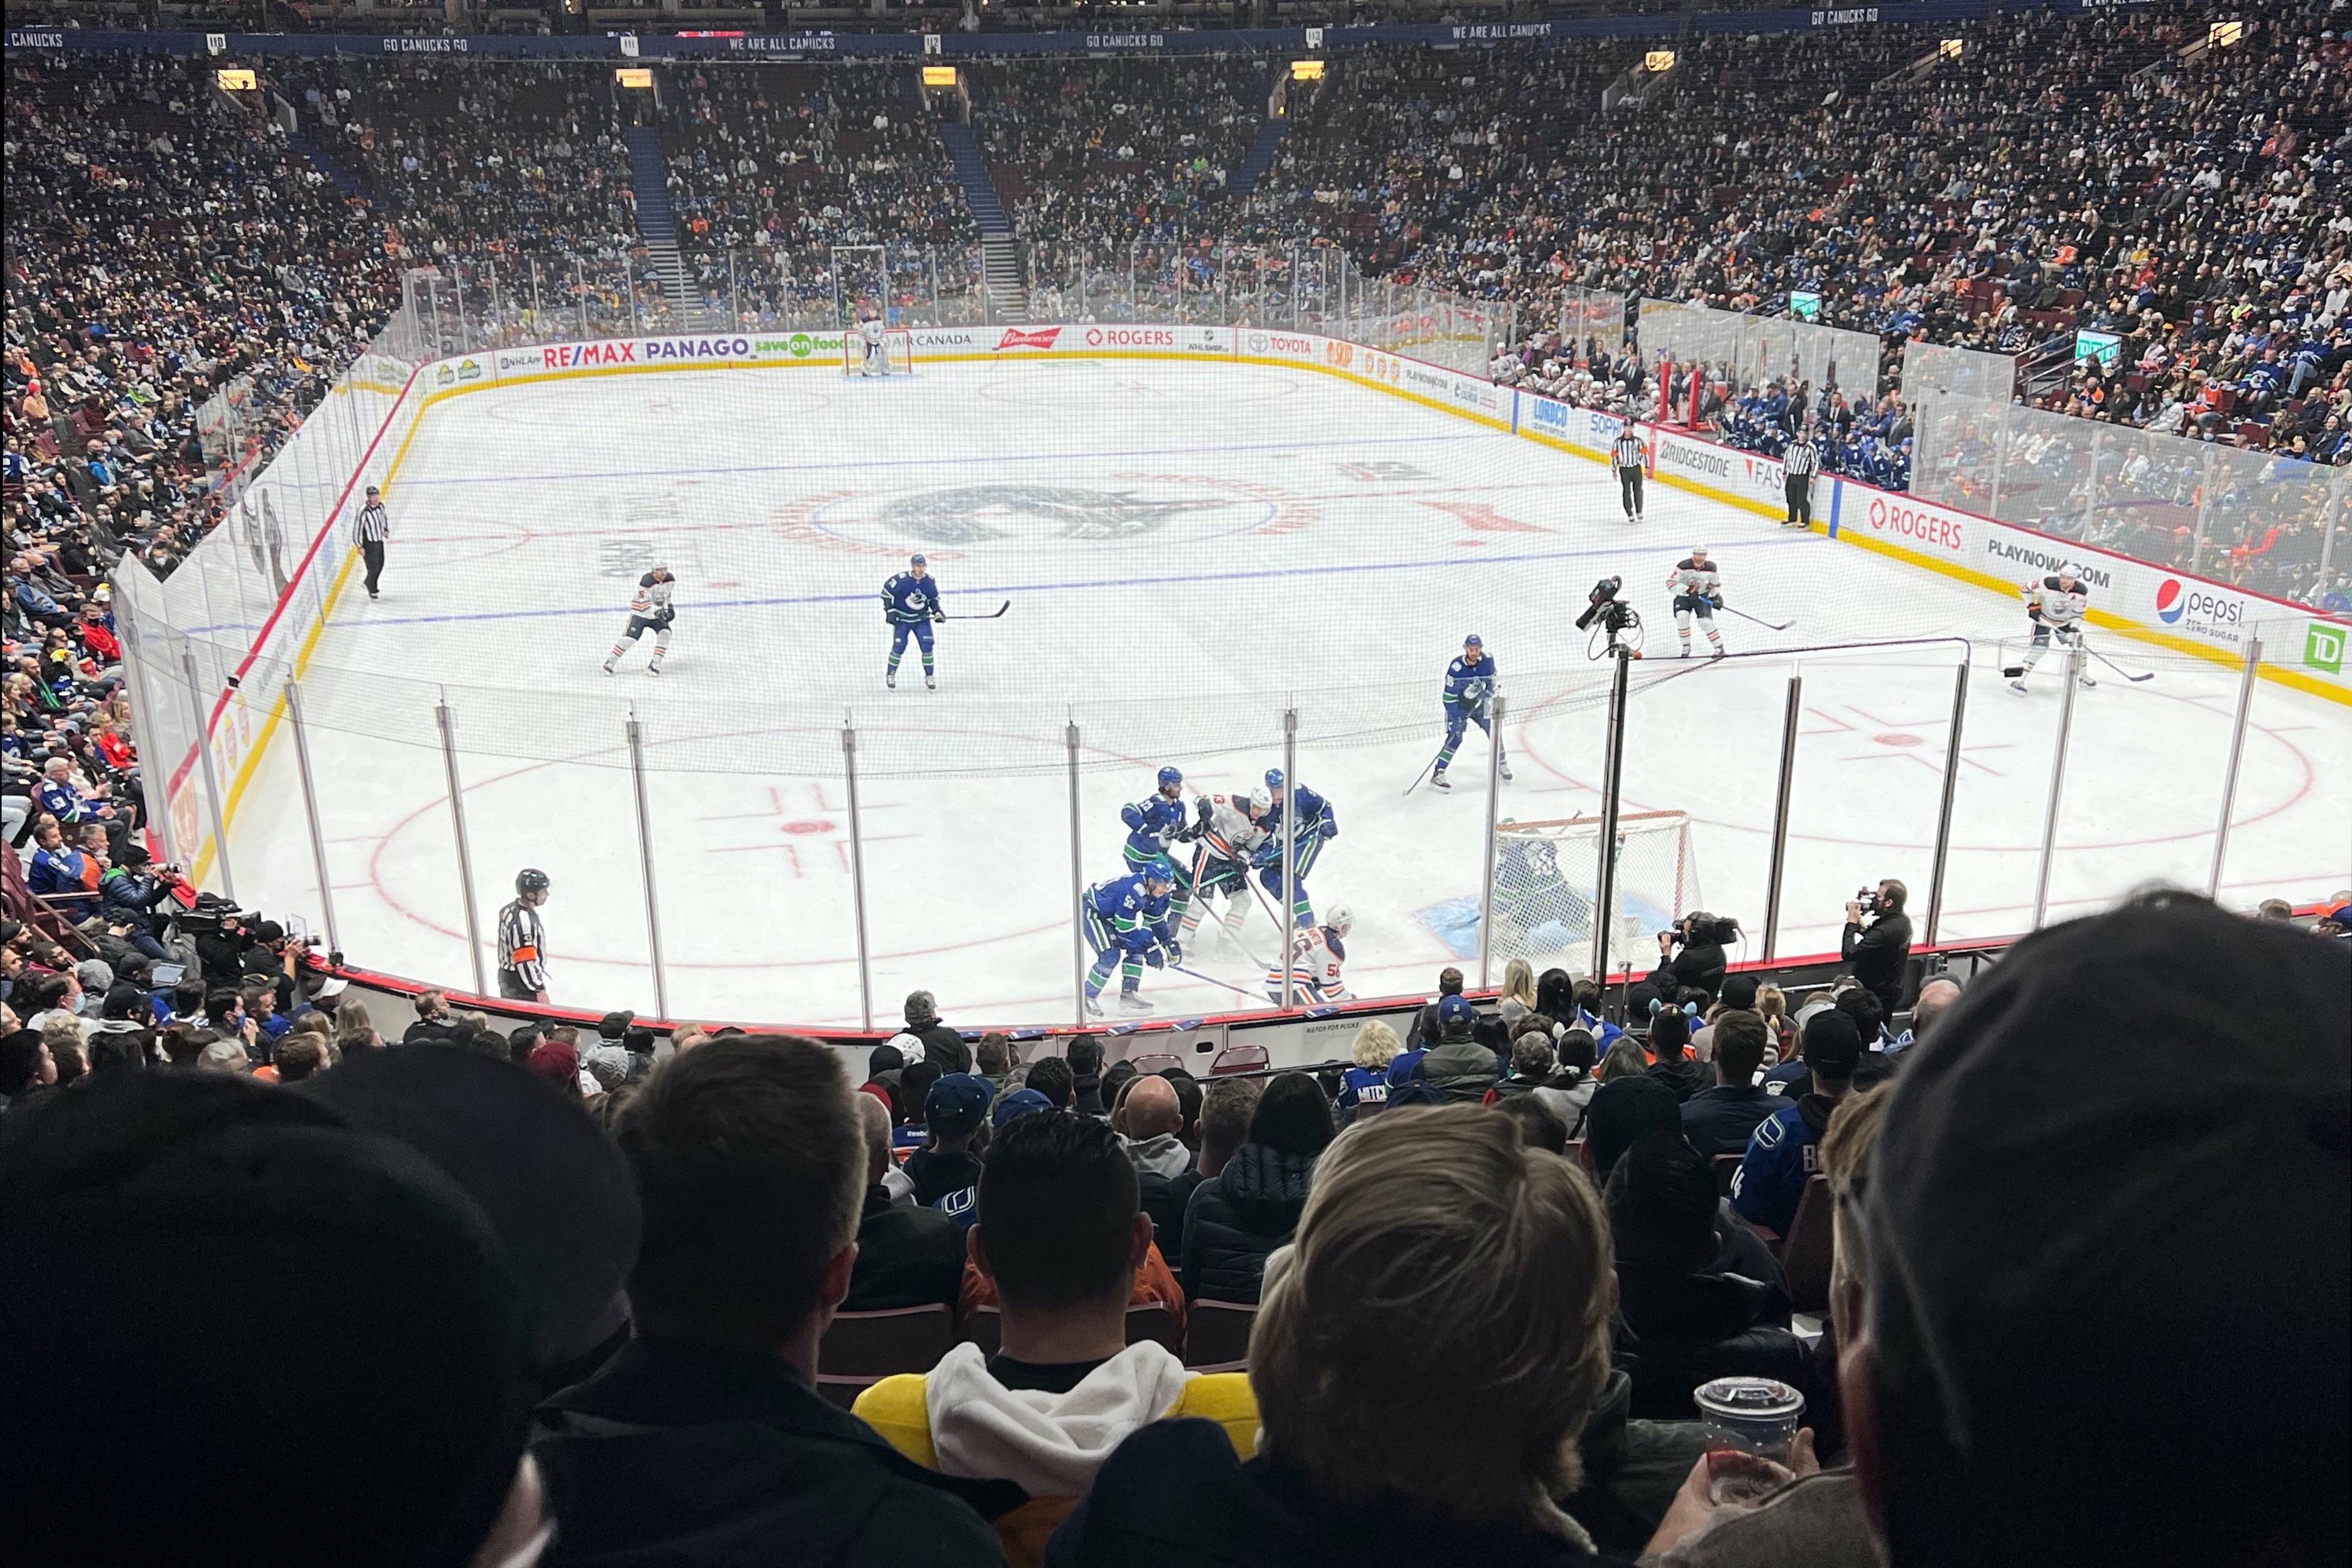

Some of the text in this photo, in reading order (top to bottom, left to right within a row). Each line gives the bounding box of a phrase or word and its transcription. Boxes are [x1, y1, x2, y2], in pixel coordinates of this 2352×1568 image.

[1811, 8, 1879, 25] GO CANUCKS GO
[12, 32, 63, 48] CANUCKS
[1308, 31, 1321, 41] 113
[1452, 24, 1551, 39] WE ARE ALL CANUCKS
[383, 38, 468, 52] GO CANUCKS GO
[729, 37, 835, 50] WE ARE ALL CANUCKS
[1087, 34, 1164, 47] GO CANUCKS GO
[755, 340, 788, 352] save
[791, 340, 810, 350] on
[916, 334, 971, 346] CANADA
[1003, 331, 1056, 345] Budweiser
[1107, 331, 1174, 345] ROGERS
[1270, 337, 1311, 354] TOYOTA
[543, 342, 636, 369] RE/MAX
[646, 338, 749, 359] PANAGO
[1659, 440, 1730, 478] BRIDGESTONE
[1754, 461, 1782, 491] FAS
[1890, 505, 1962, 550] ROGERS
[2187, 592, 2244, 627] pepsi
[2185, 619, 2239, 643] ZERO SUGAR
[2310, 631, 2340, 664] TD
[1357, 1084, 1387, 1102] MITC
